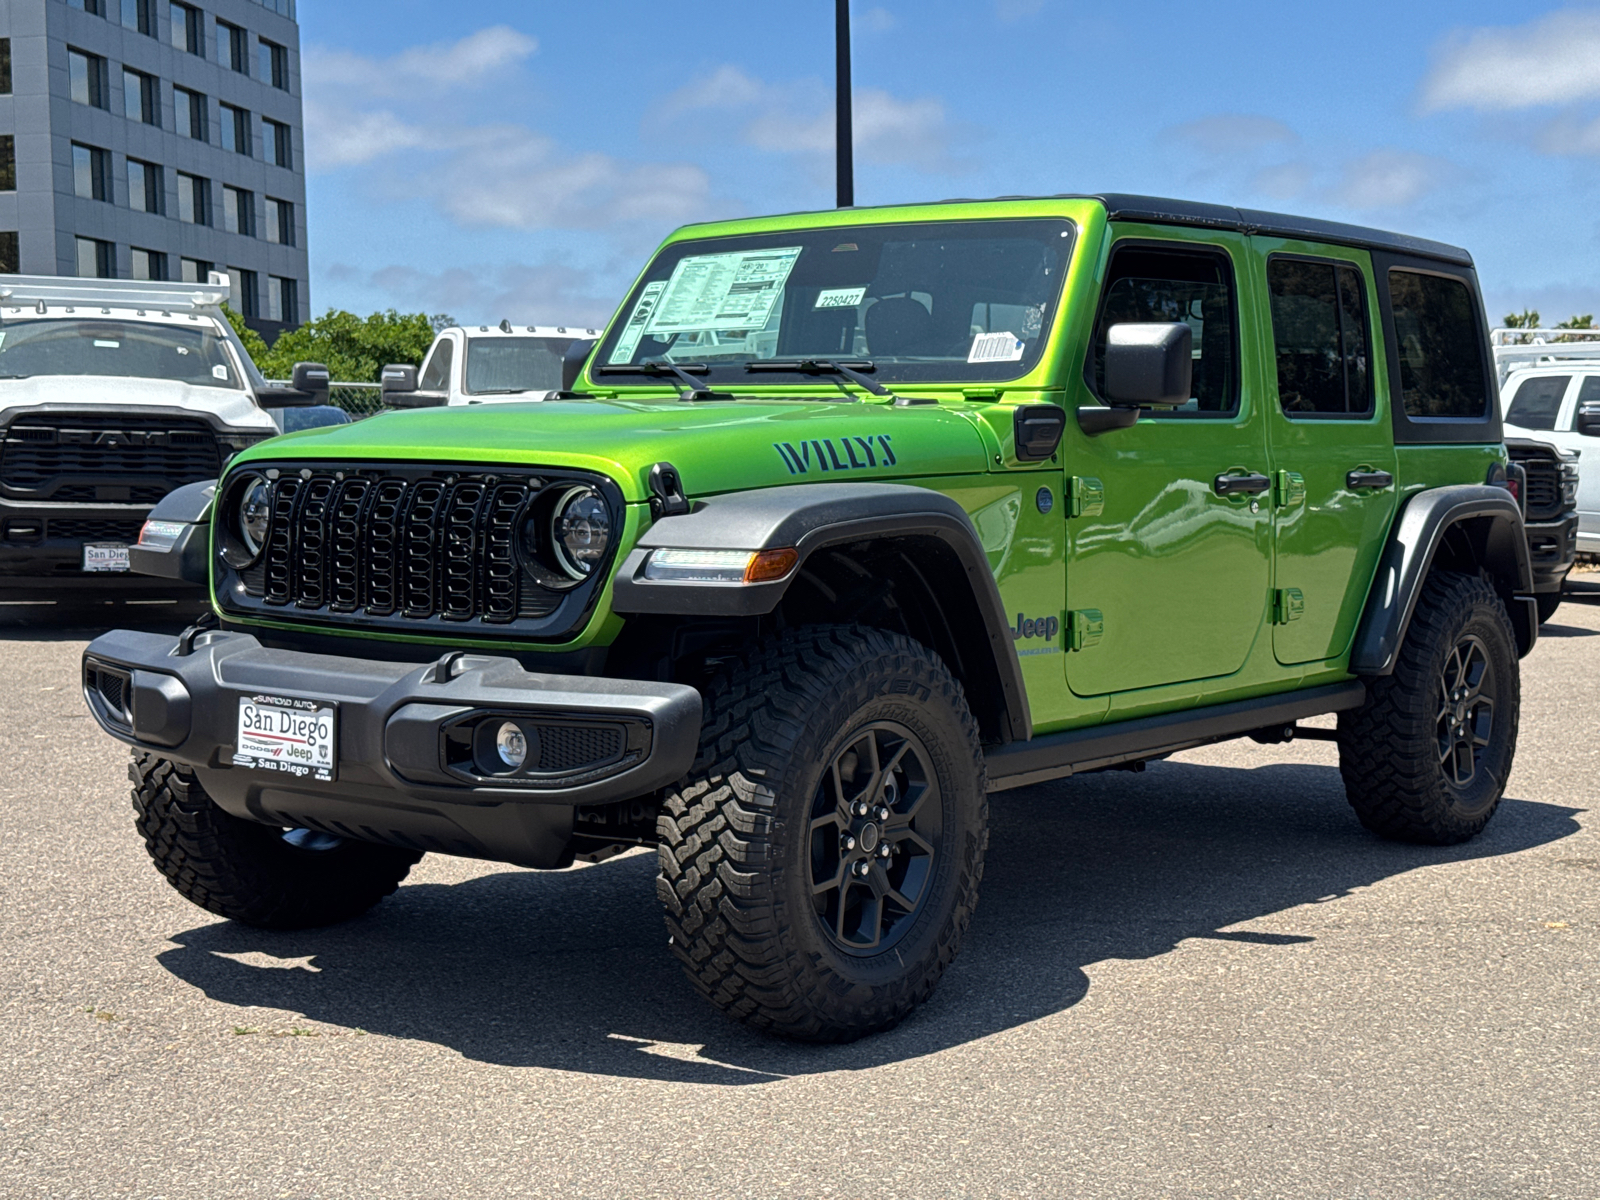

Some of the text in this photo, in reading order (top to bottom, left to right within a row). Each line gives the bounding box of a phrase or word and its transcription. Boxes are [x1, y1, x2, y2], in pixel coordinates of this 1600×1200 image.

[820, 294, 860, 306] 2250427
[772, 434, 896, 475] WILLYS
[88, 549, 130, 561] San Dieg
[1009, 612, 1059, 642] Jeep
[293, 700, 314, 709] AUTO
[243, 705, 328, 747] San Diego
[286, 743, 313, 762] Jeep
[258, 758, 278, 769] San
[279, 761, 309, 776] Diego
